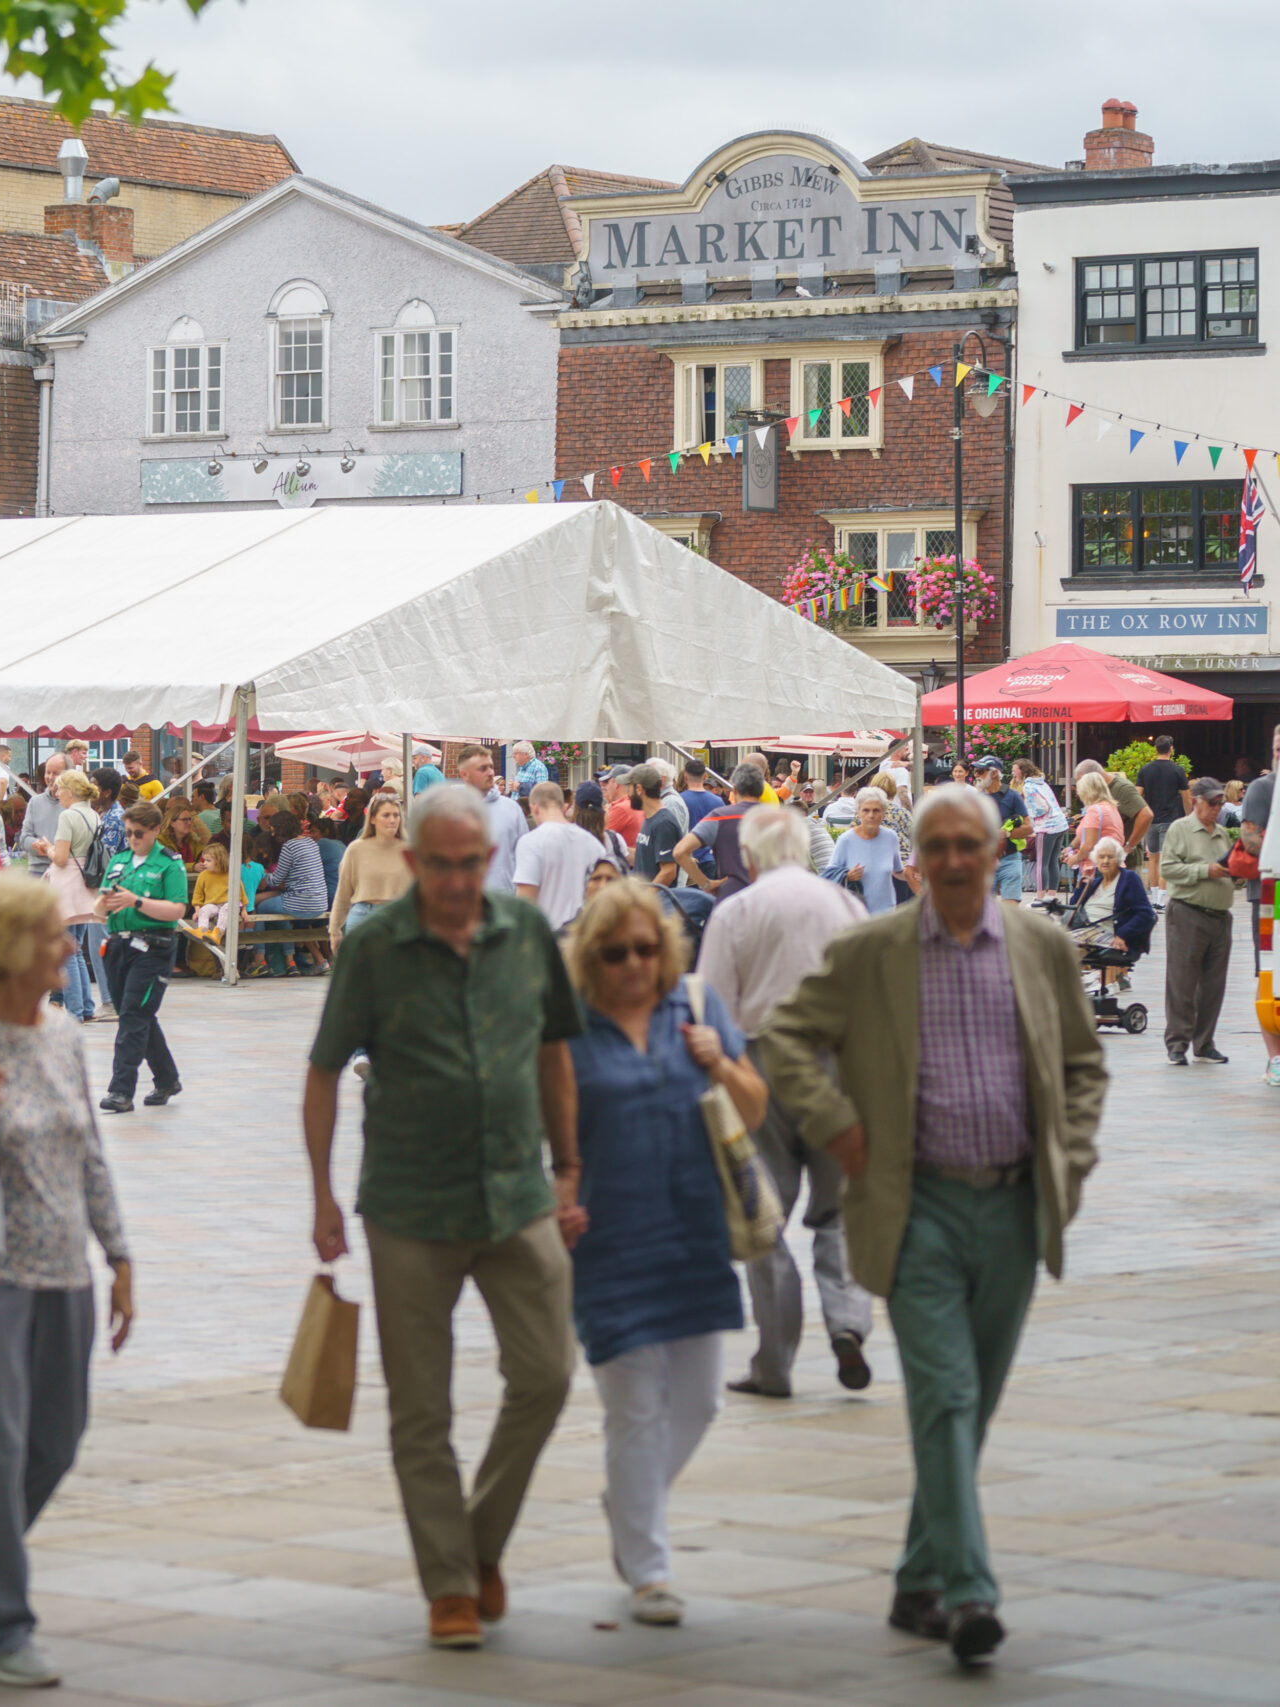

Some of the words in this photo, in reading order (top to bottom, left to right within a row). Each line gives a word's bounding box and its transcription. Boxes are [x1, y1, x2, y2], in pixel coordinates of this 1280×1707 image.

[725, 172, 784, 199] GIBBS
[789, 165, 840, 196] MEW
[751, 201, 782, 211] CIRCA
[785, 197, 812, 209] 1742
[602, 215, 842, 270] MARKET
[861, 207, 968, 256] INN
[271, 471, 320, 498] Allium
[1066, 615, 1111, 630] THE
[1121, 614, 1149, 629] OX
[1159, 614, 1208, 629] ROW
[1217, 613, 1259, 629] INN
[1174, 658, 1184, 669] &
[1195, 658, 1260, 669] TURNER
[1006, 674, 1065, 683] LONDON
[1009, 679, 1052, 687] PRIDE
[975, 707, 1023, 719] ORIGINAL
[1025, 707, 1072, 718] ORIGINAL
[838, 758, 871, 768] WINES
